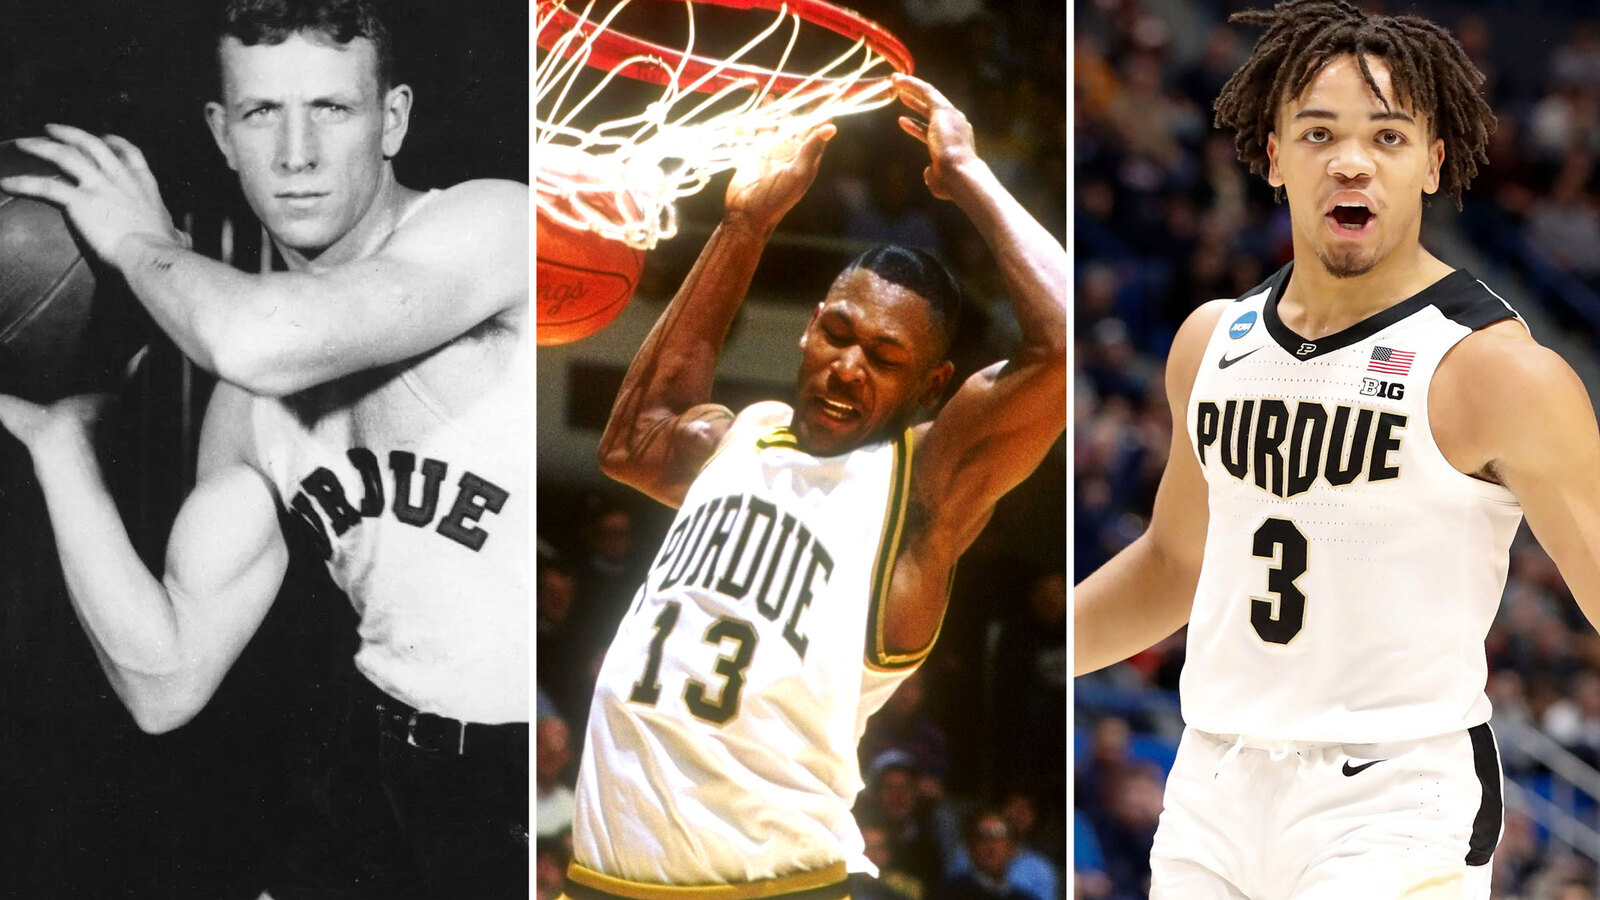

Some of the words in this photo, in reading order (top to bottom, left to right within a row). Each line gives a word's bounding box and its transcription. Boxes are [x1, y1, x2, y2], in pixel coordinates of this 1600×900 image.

[1296, 343, 1317, 355] P
[291, 447, 510, 560] URDUE
[1196, 399, 1409, 500] PURDUE
[635, 493, 834, 666] PURDUE
[1248, 515, 1311, 646] 3
[626, 600, 760, 729] 13
